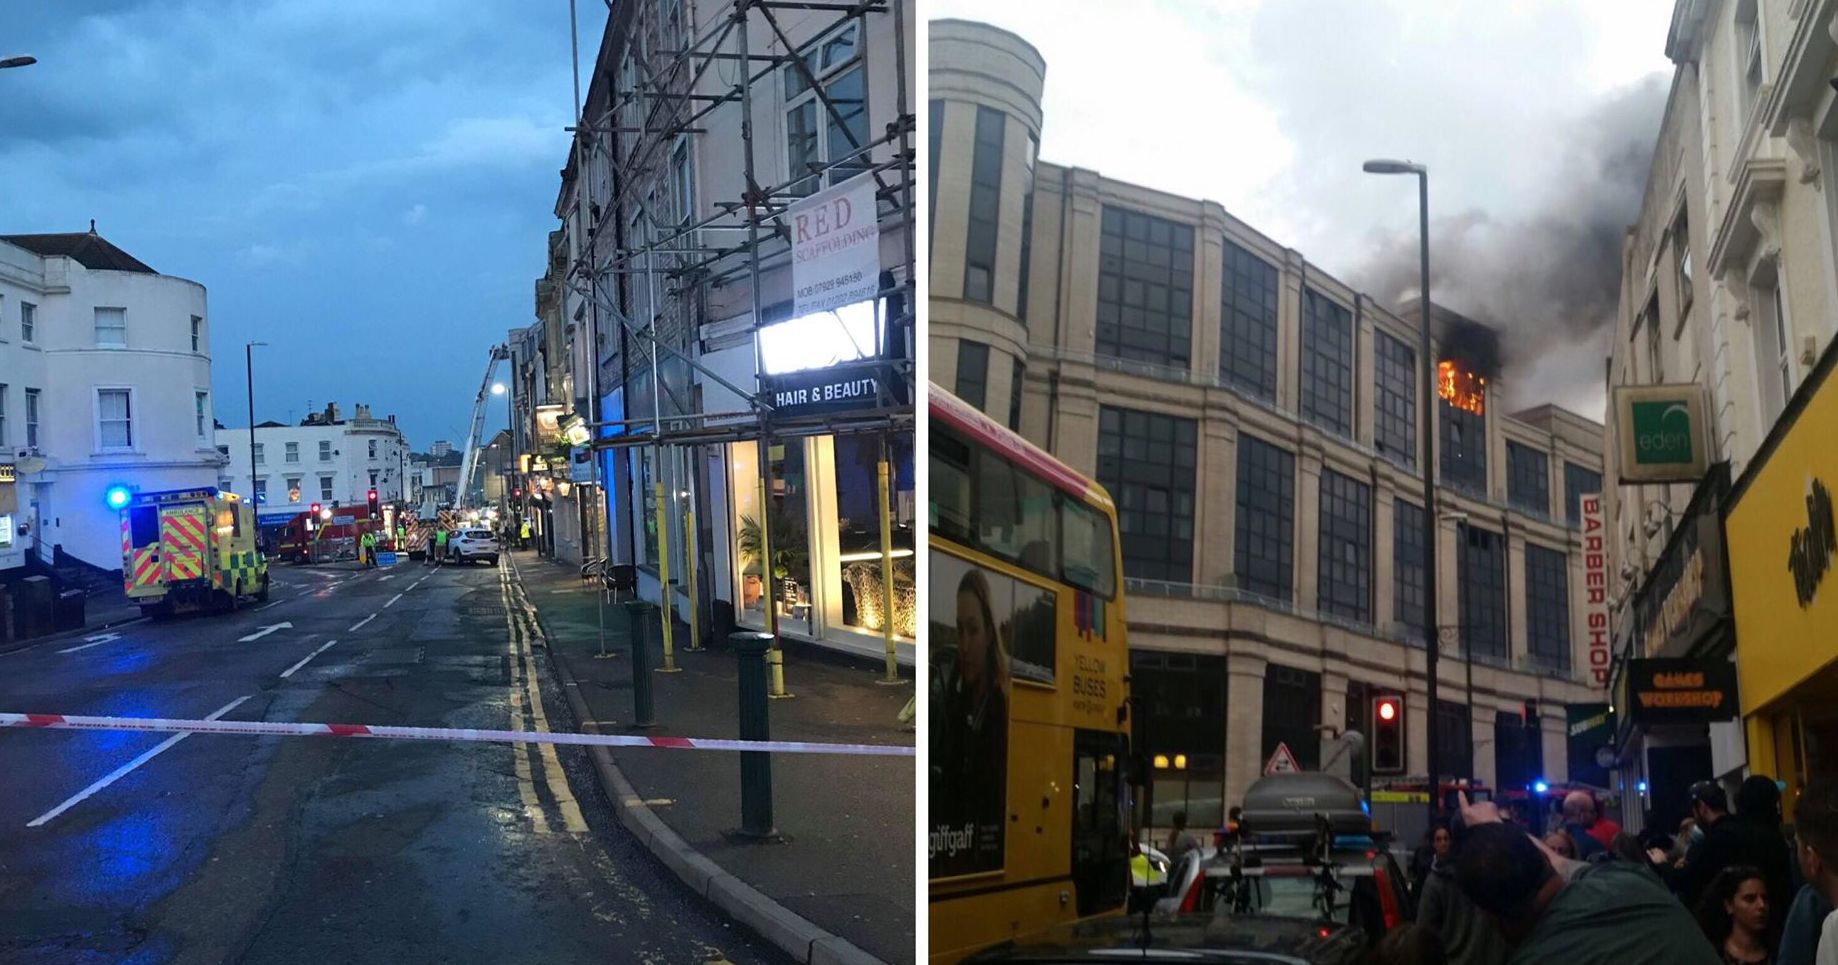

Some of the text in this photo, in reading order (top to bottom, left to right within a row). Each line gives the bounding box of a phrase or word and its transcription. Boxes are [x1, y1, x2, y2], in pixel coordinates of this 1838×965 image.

[795, 197, 852, 245] RED
[796, 226, 876, 263] SCAFFOLDING
[776, 378, 878, 407] HAIR & BEAUTY
[1639, 430, 1688, 450] eden
[1583, 499, 1609, 684] BARBER SHOP
[1073, 654, 1106, 673] YELLOW
[1073, 674, 1106, 698] BUSES
[1653, 672, 1704, 688] GAMES
[1637, 690, 1723, 709] WORKSHOP
[928, 823, 974, 858] giffgaff
